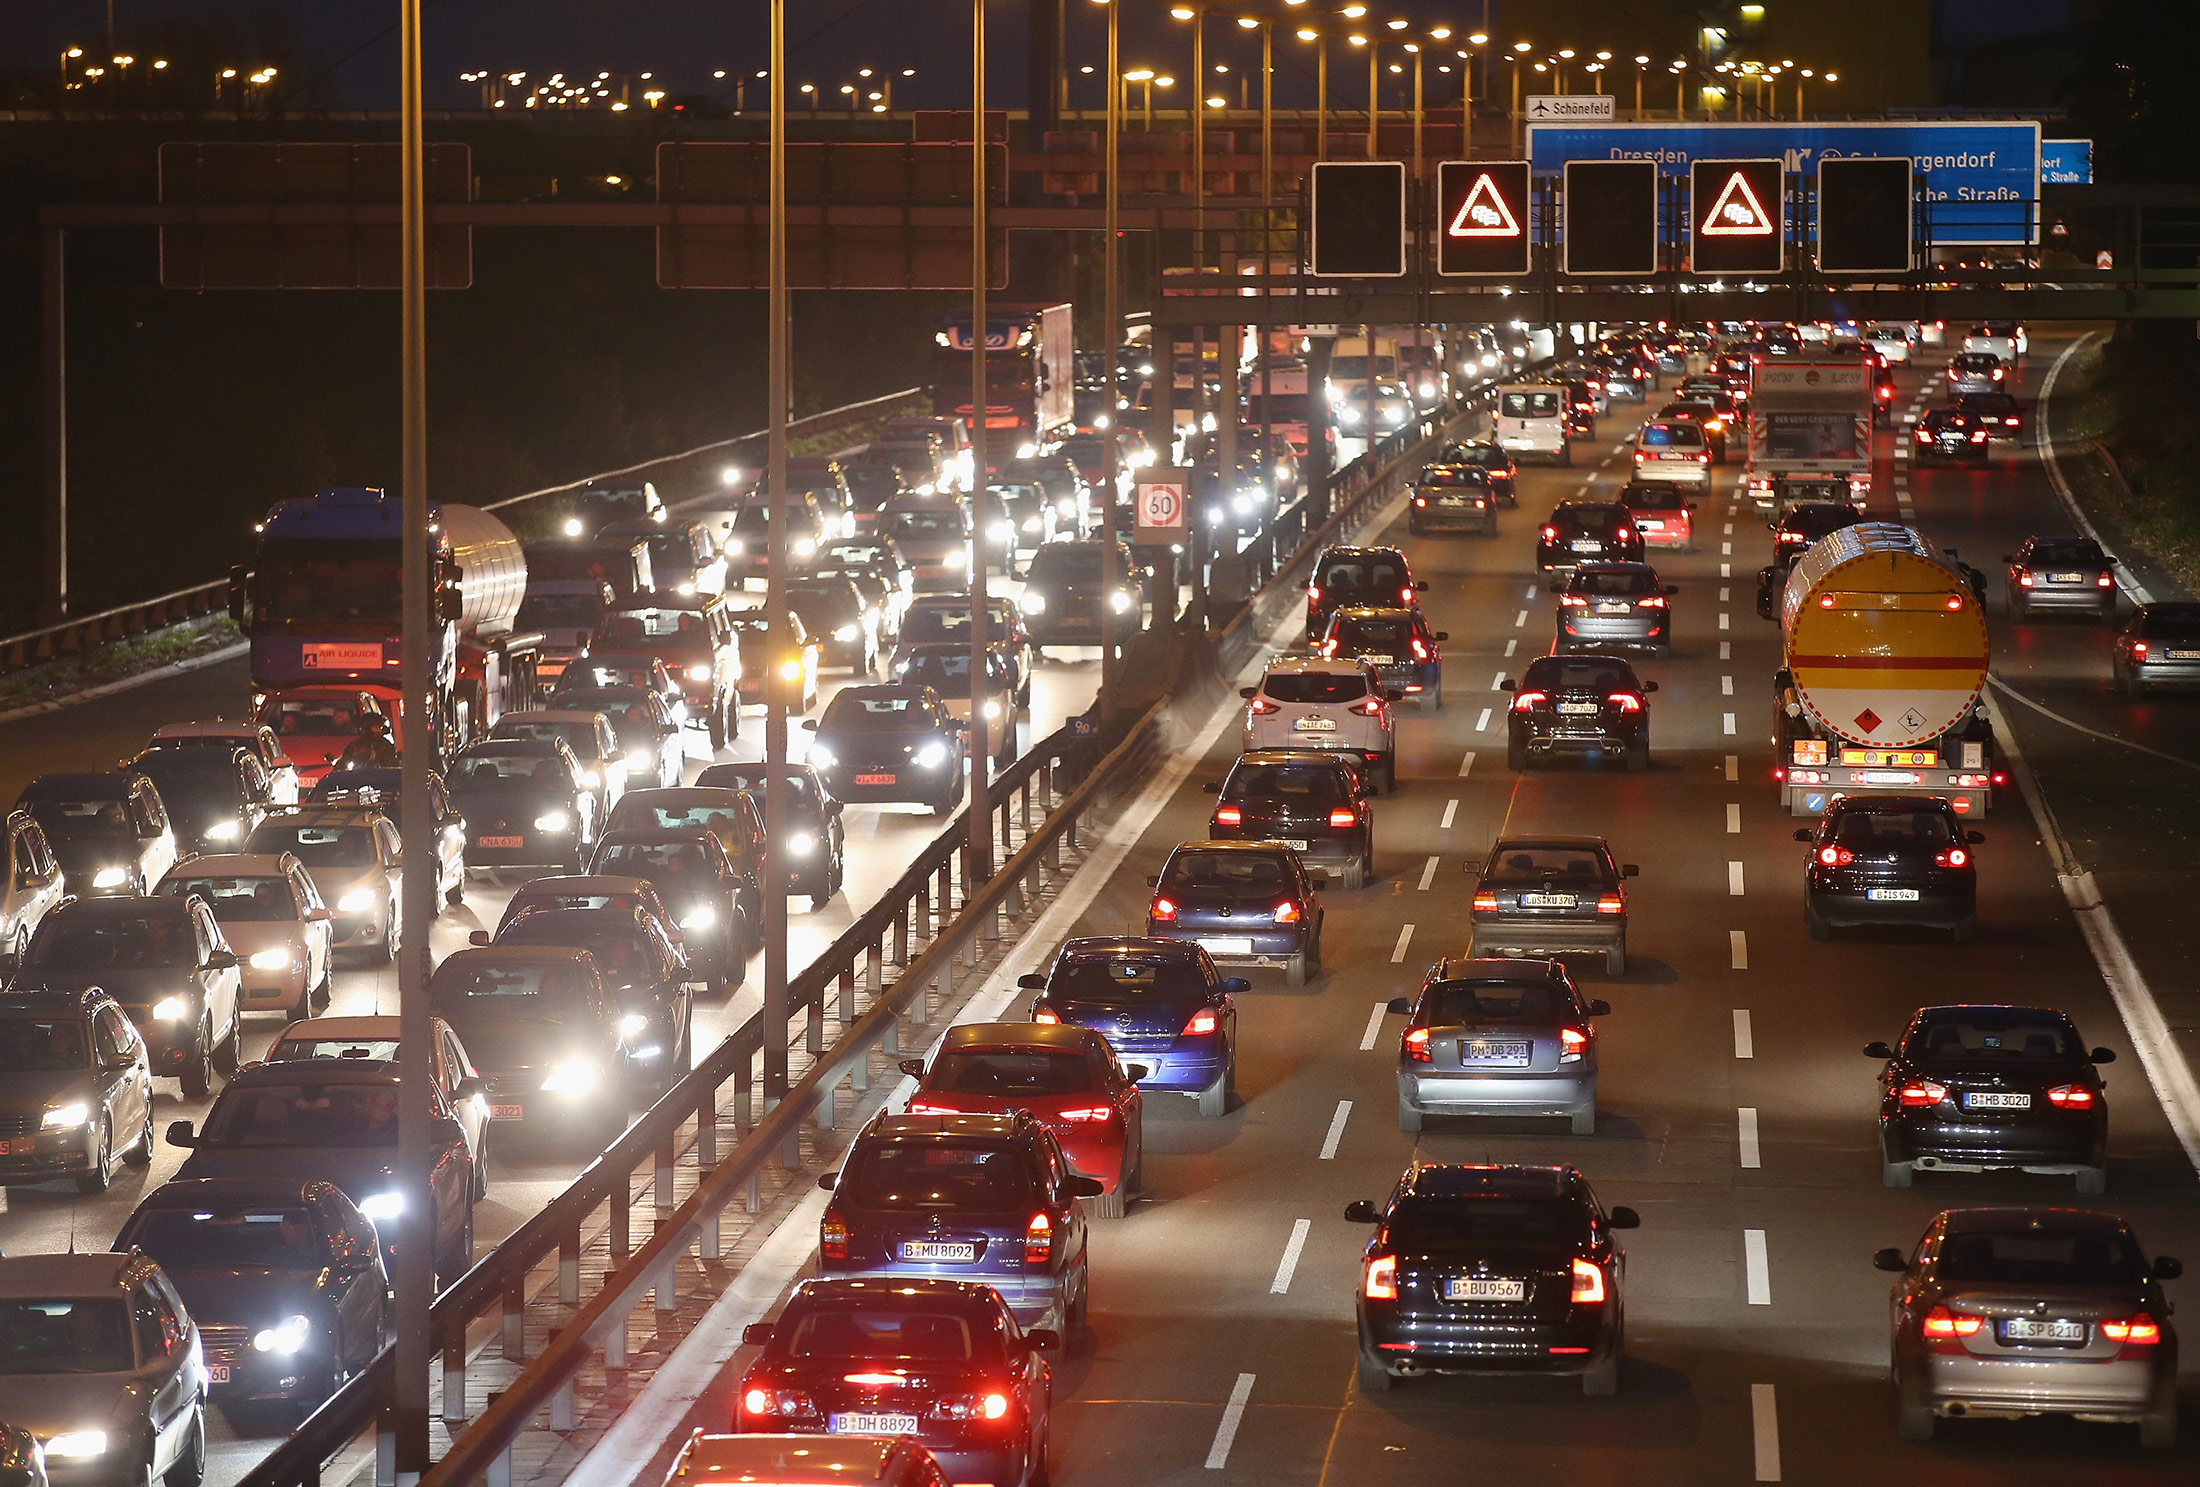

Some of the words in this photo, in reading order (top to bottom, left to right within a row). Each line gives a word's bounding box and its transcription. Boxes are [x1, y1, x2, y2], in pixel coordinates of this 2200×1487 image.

[1553, 102, 1610, 115] Schönefeld
[1610, 147, 1688, 164] Dresden
[1957, 186, 2020, 201] Straße
[1150, 496, 1172, 515] 60
[1526, 896, 1542, 905] LDS
[1546, 896, 1558, 905] KU
[1559, 896, 1573, 905] 370
[1900, 891, 1916, 899] 949
[1471, 1045, 1485, 1055] PM
[1491, 1045, 1505, 1055] DB
[1506, 1045, 1526, 1055] 291
[1971, 1094, 1979, 1105] B
[1985, 1095, 2000, 1105] HB
[2002, 1095, 2029, 1106] 3020
[495, 1106, 521, 1117] 3021
[905, 1244, 914, 1257] B
[921, 1245, 939, 1257] MU
[940, 1246, 972, 1258] 8092
[1453, 1283, 1461, 1295] B
[1470, 1283, 1487, 1295] BU
[1489, 1283, 1521, 1296] 9567
[2009, 1323, 2018, 1336] B
[2027, 1323, 2045, 1337] SP
[2047, 1324, 2081, 1338] 8210
[211, 1367, 228, 1381] 60
[838, 1416, 848, 1431] B
[858, 1417, 877, 1431] DH
[879, 1418, 916, 1432] 8892
